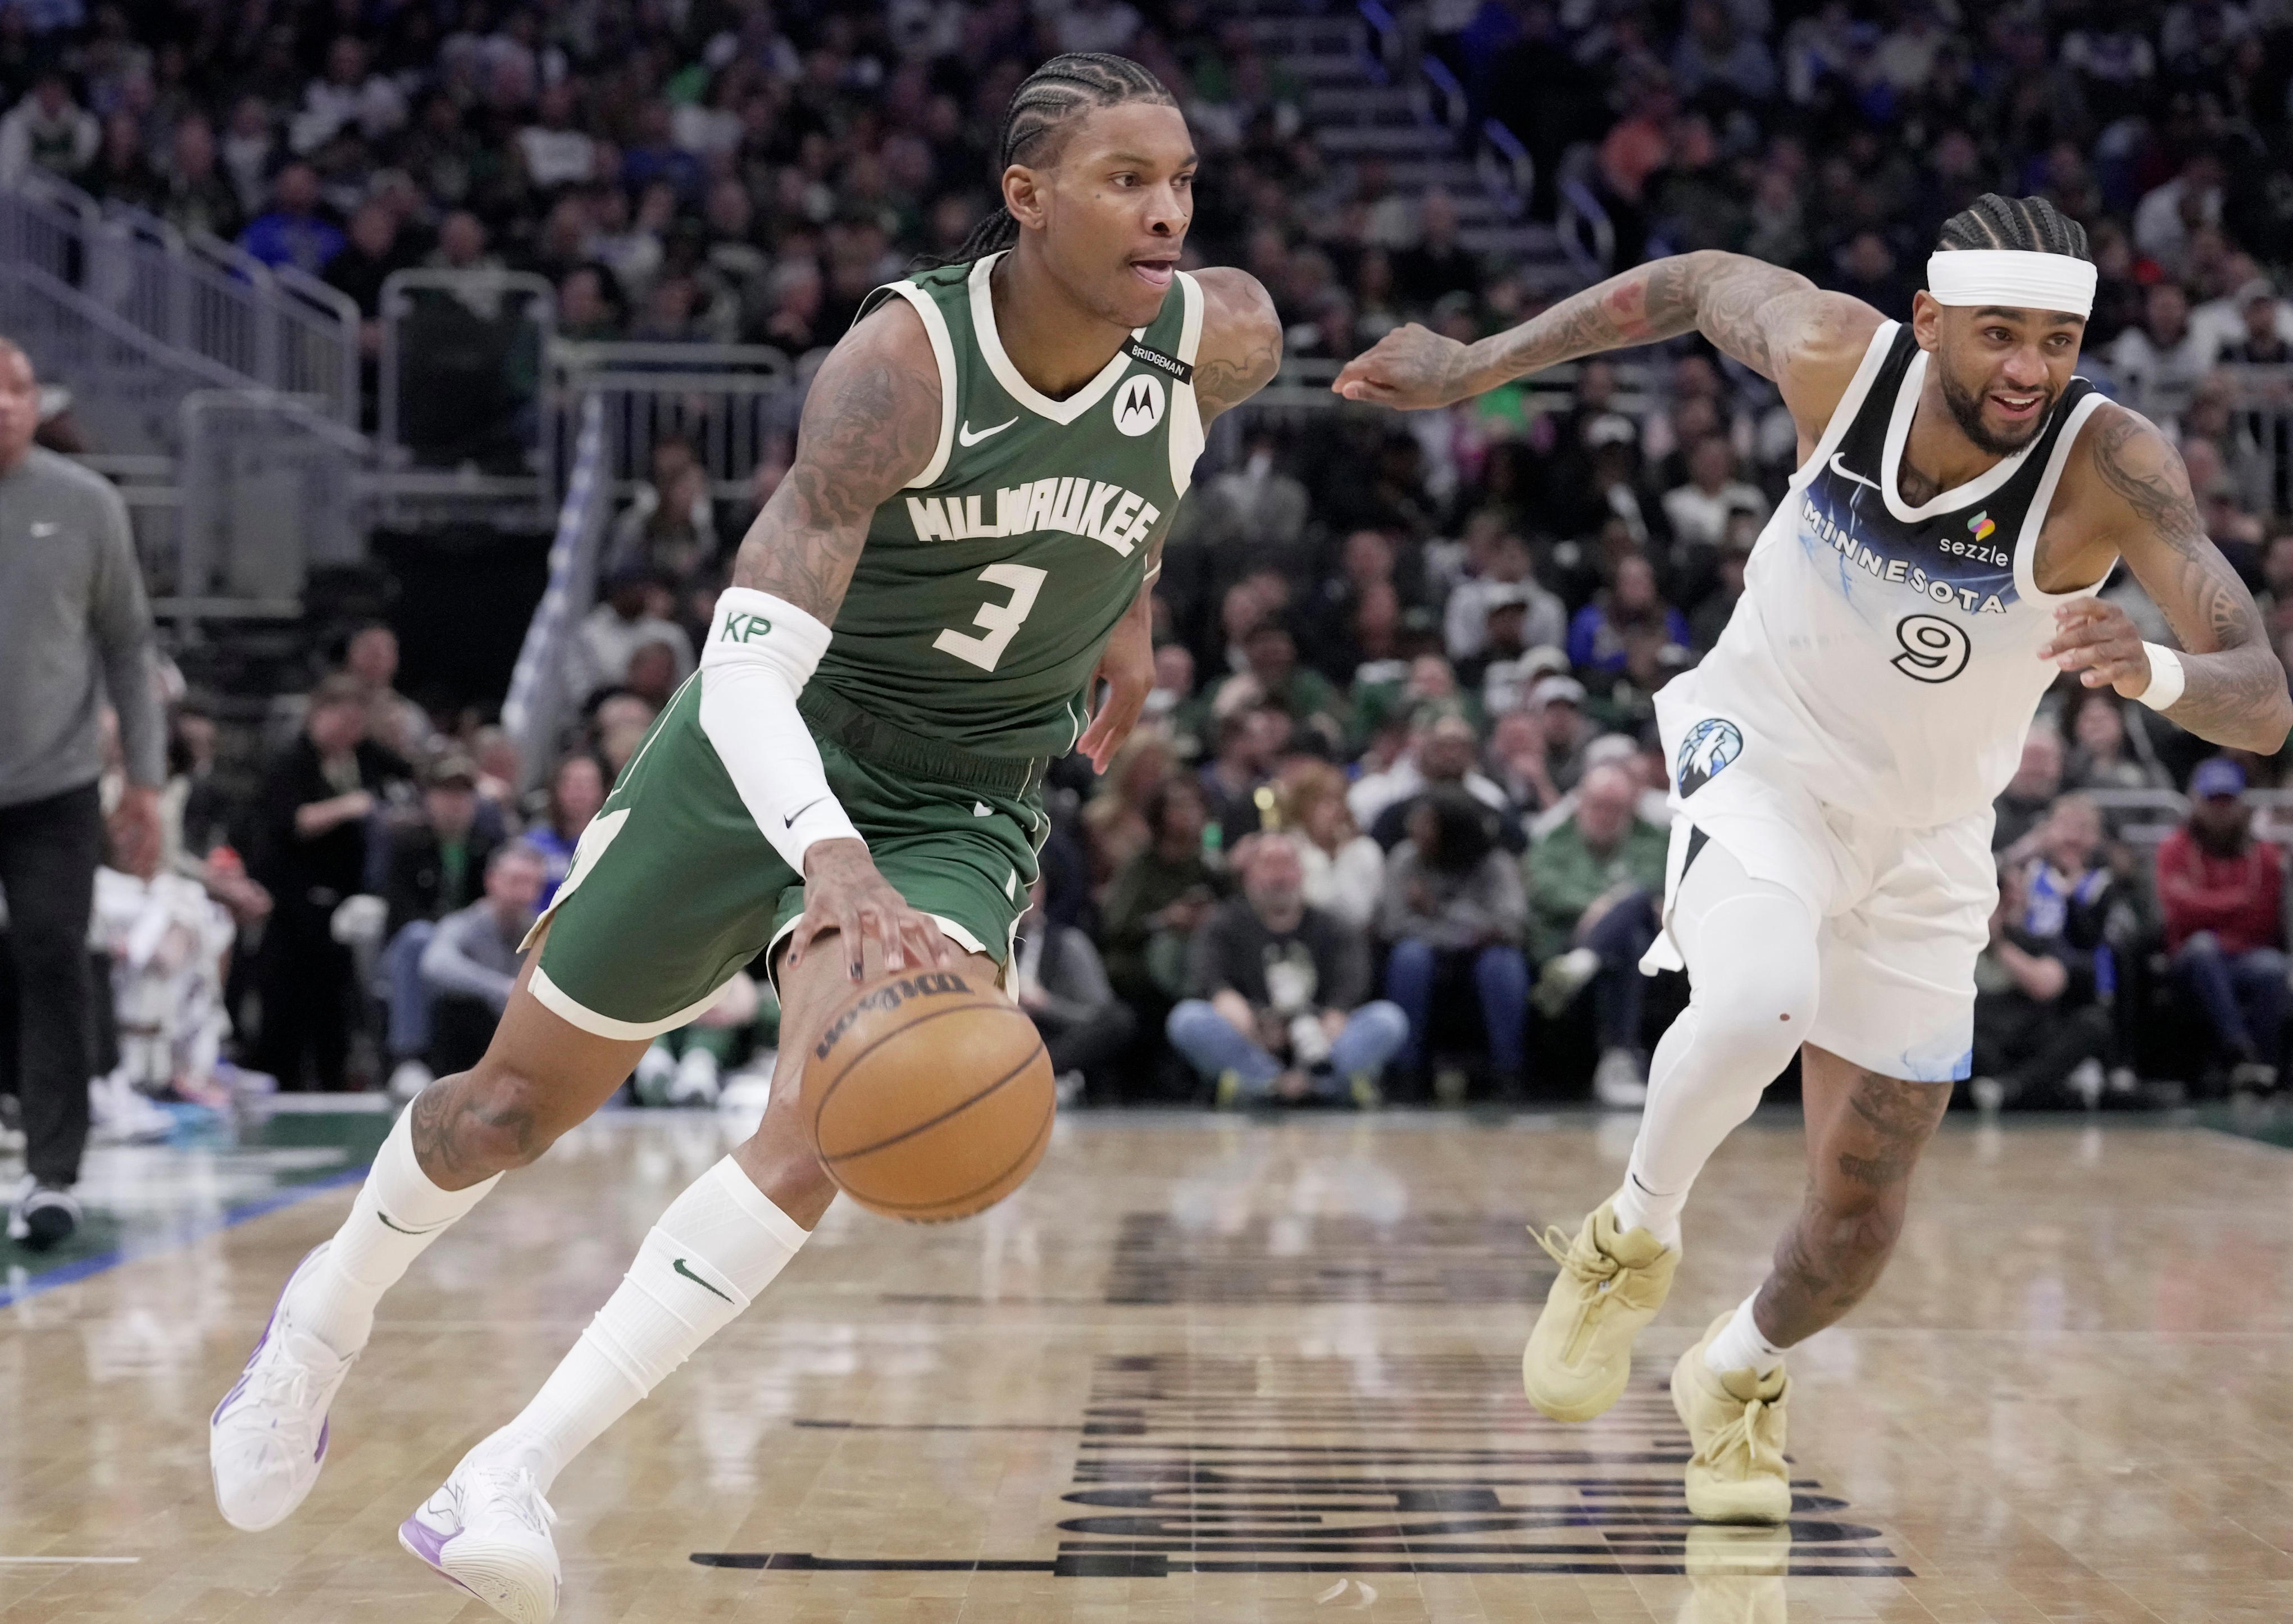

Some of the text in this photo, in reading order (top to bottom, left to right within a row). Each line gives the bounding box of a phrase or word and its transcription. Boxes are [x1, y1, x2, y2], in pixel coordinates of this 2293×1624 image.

[1131, 344, 1185, 376] BRIDGEMAN
[906, 476, 1161, 558] MILWAUKEE
[1802, 498, 2007, 614] MINNESOTA
[1939, 538, 2009, 567] sezzle
[720, 612, 771, 644] KP
[931, 563, 1048, 673] 3
[1890, 614, 1971, 684] 9
